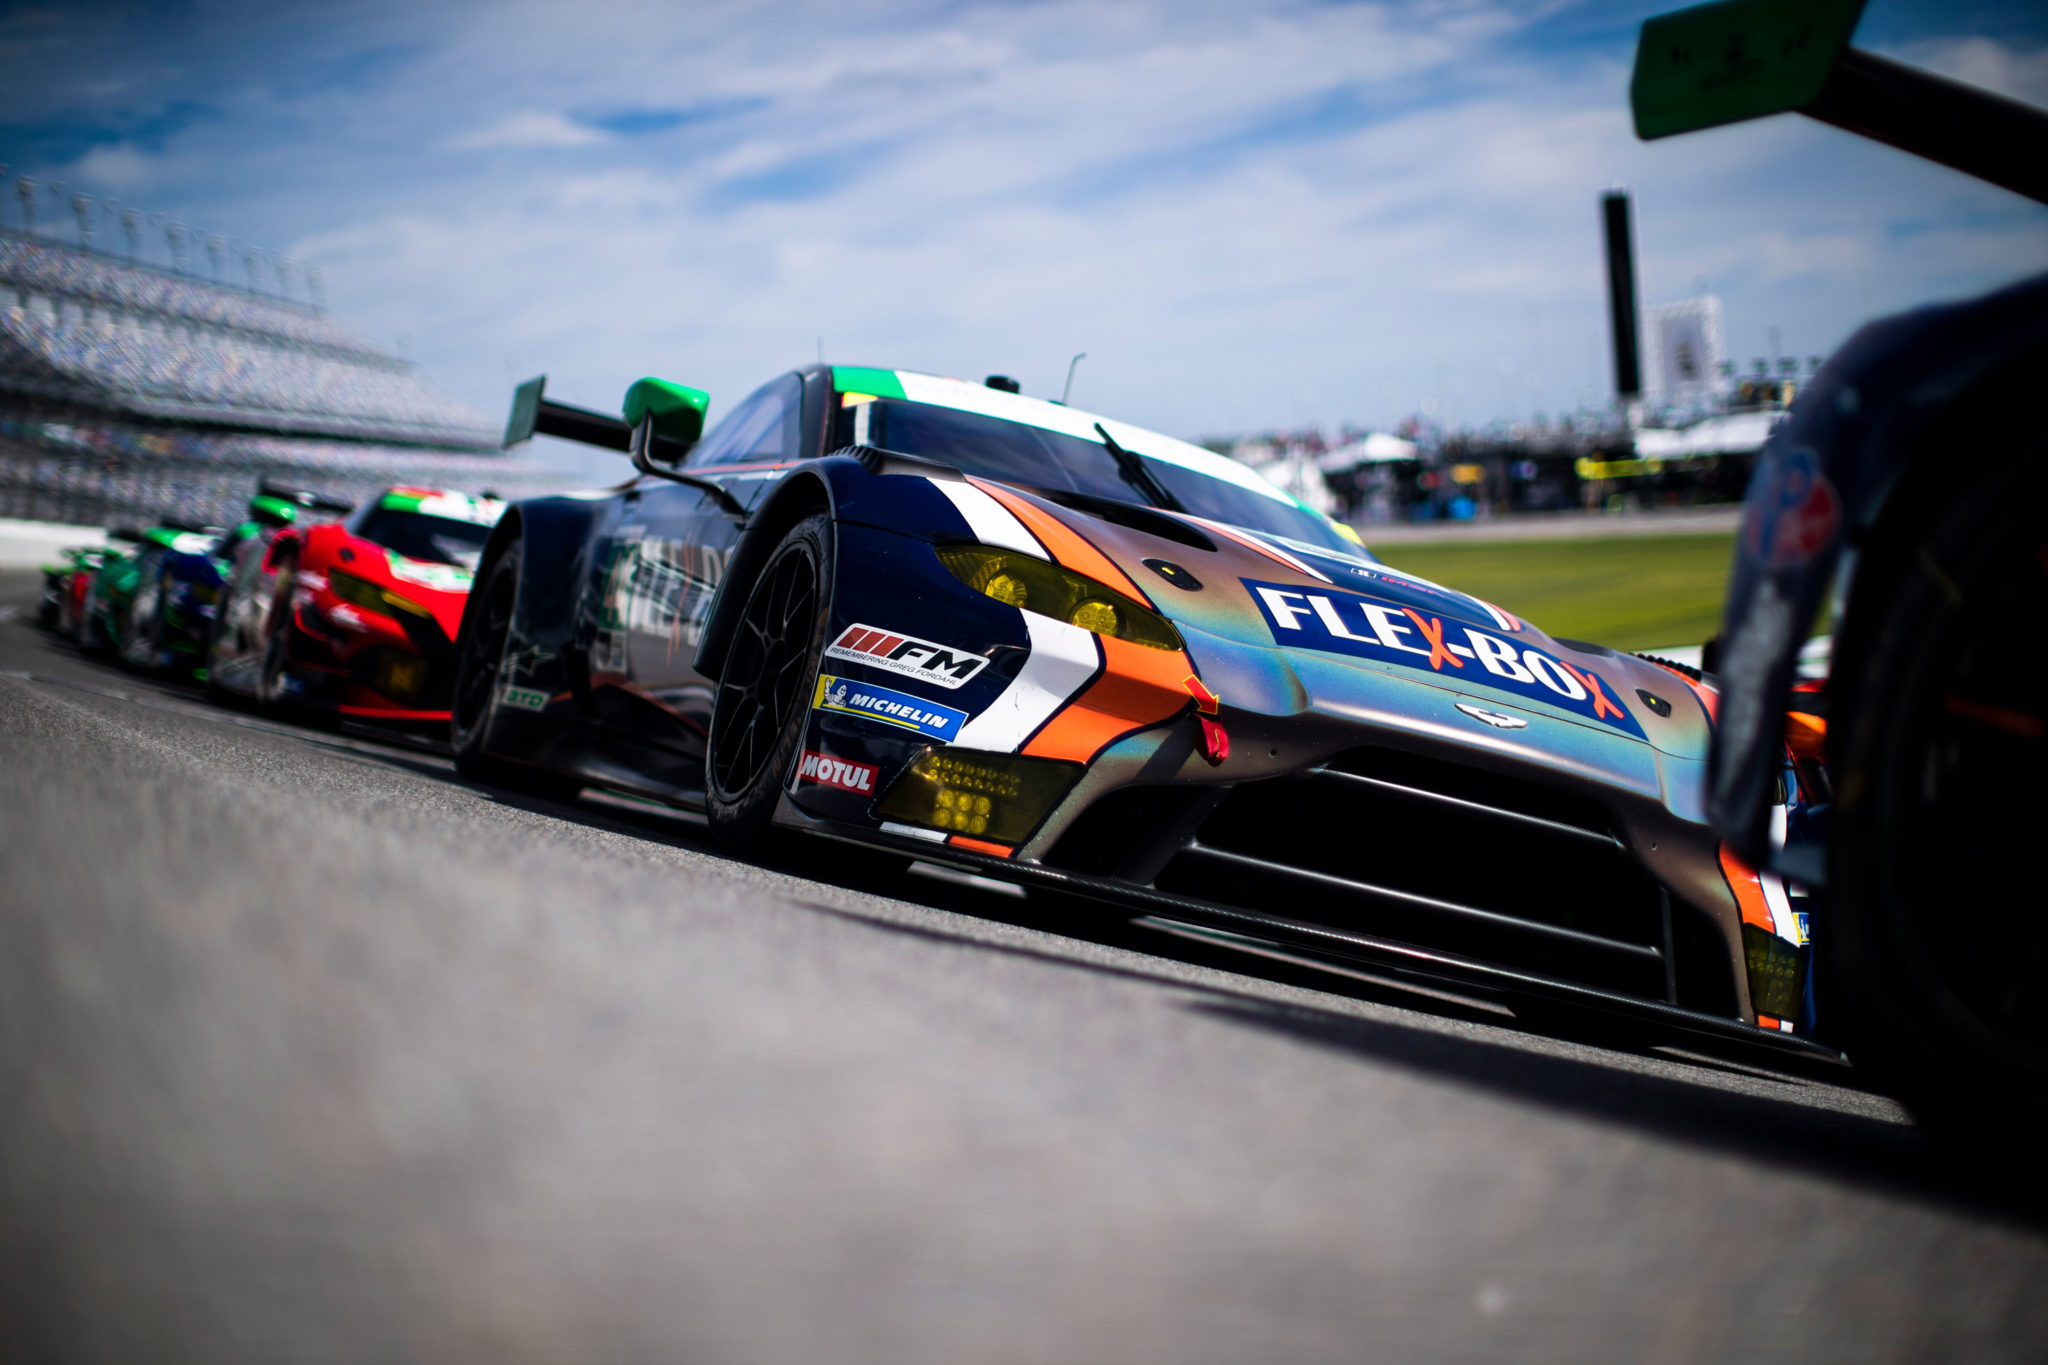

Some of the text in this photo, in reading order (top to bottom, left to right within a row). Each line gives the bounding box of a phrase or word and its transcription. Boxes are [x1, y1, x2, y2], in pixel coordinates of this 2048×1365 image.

[830, 647, 958, 687] REMEMBERING GREG FORDAHL
[887, 641, 983, 679] FM
[1255, 586, 1625, 720] FLEX-BOX
[850, 693, 949, 729] MICHELIN
[801, 754, 872, 791] MOTUL
